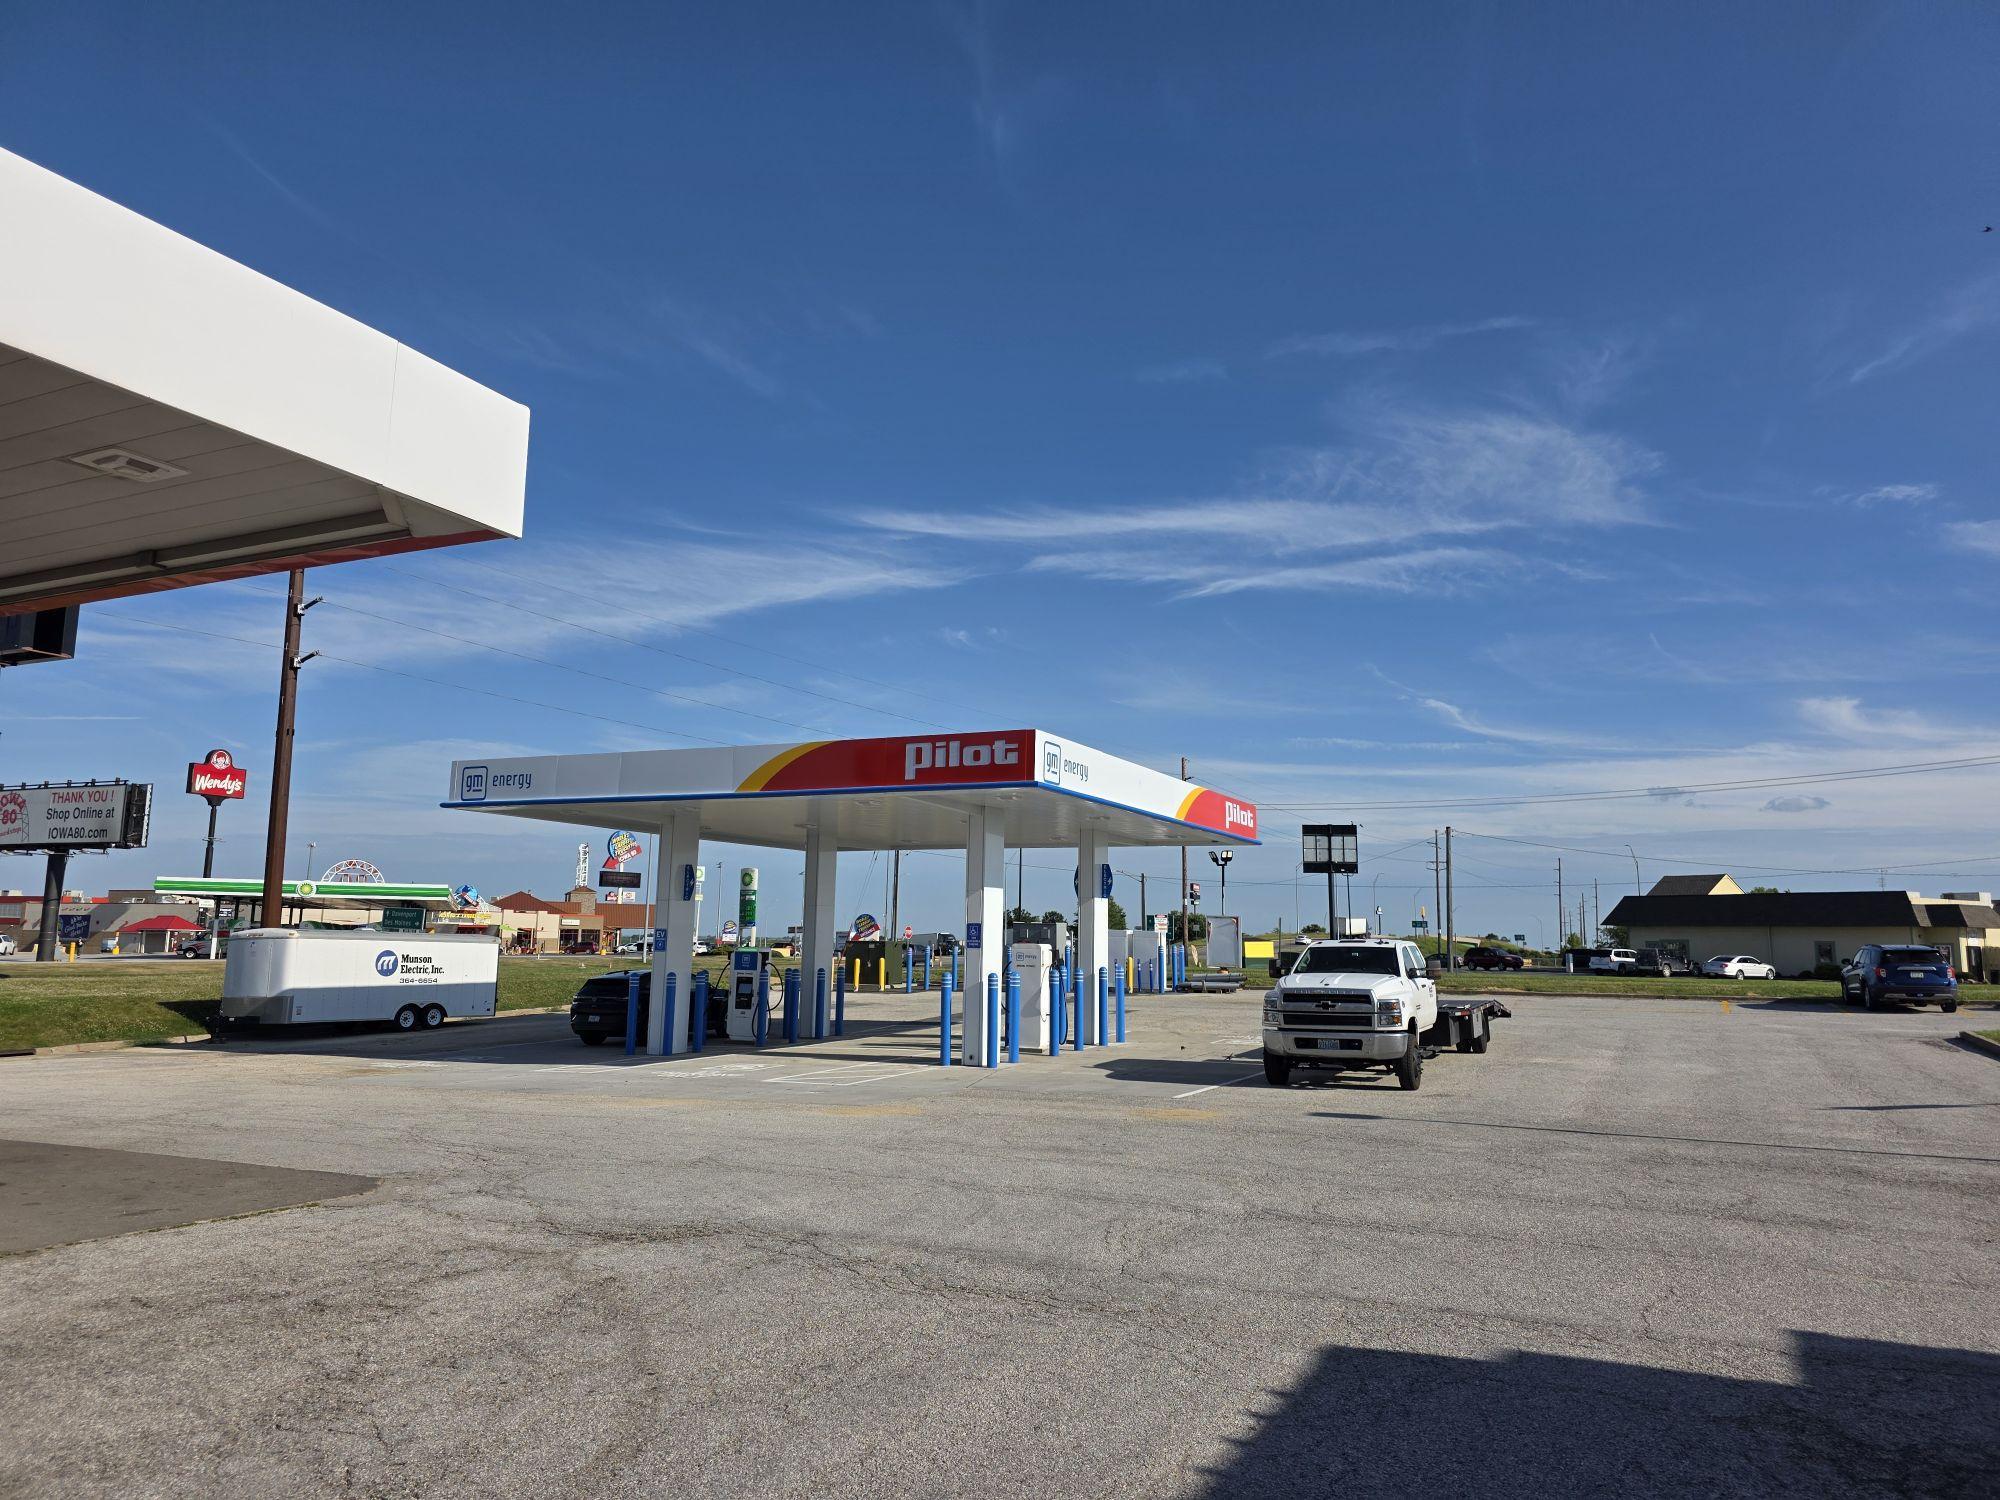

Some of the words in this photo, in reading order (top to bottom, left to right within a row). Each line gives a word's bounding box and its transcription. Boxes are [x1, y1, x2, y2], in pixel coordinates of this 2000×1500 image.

[1063, 759, 1089, 782] energy
[195, 774, 242, 794] Wendy's
[466, 774, 483, 792] gm
[492, 773, 532, 789] energy
[0, 791, 26, 811] OWA
[51, 790, 84, 804] THANK
[87, 790, 109, 802] YOU
[2, 809, 17, 825] 80
[46, 807, 70, 822] Shop
[72, 806, 103, 819] Online
[105, 806, 115, 818] at
[48, 827, 108, 840] IOWA80.com
[384, 918, 393, 926] Des
[394, 919, 412, 927] Moines
[391, 910, 417, 920] Davenport
[401, 954, 432, 963] Munson
[400, 965, 430, 975] Electric,
[431, 965, 445, 974] Inc.
